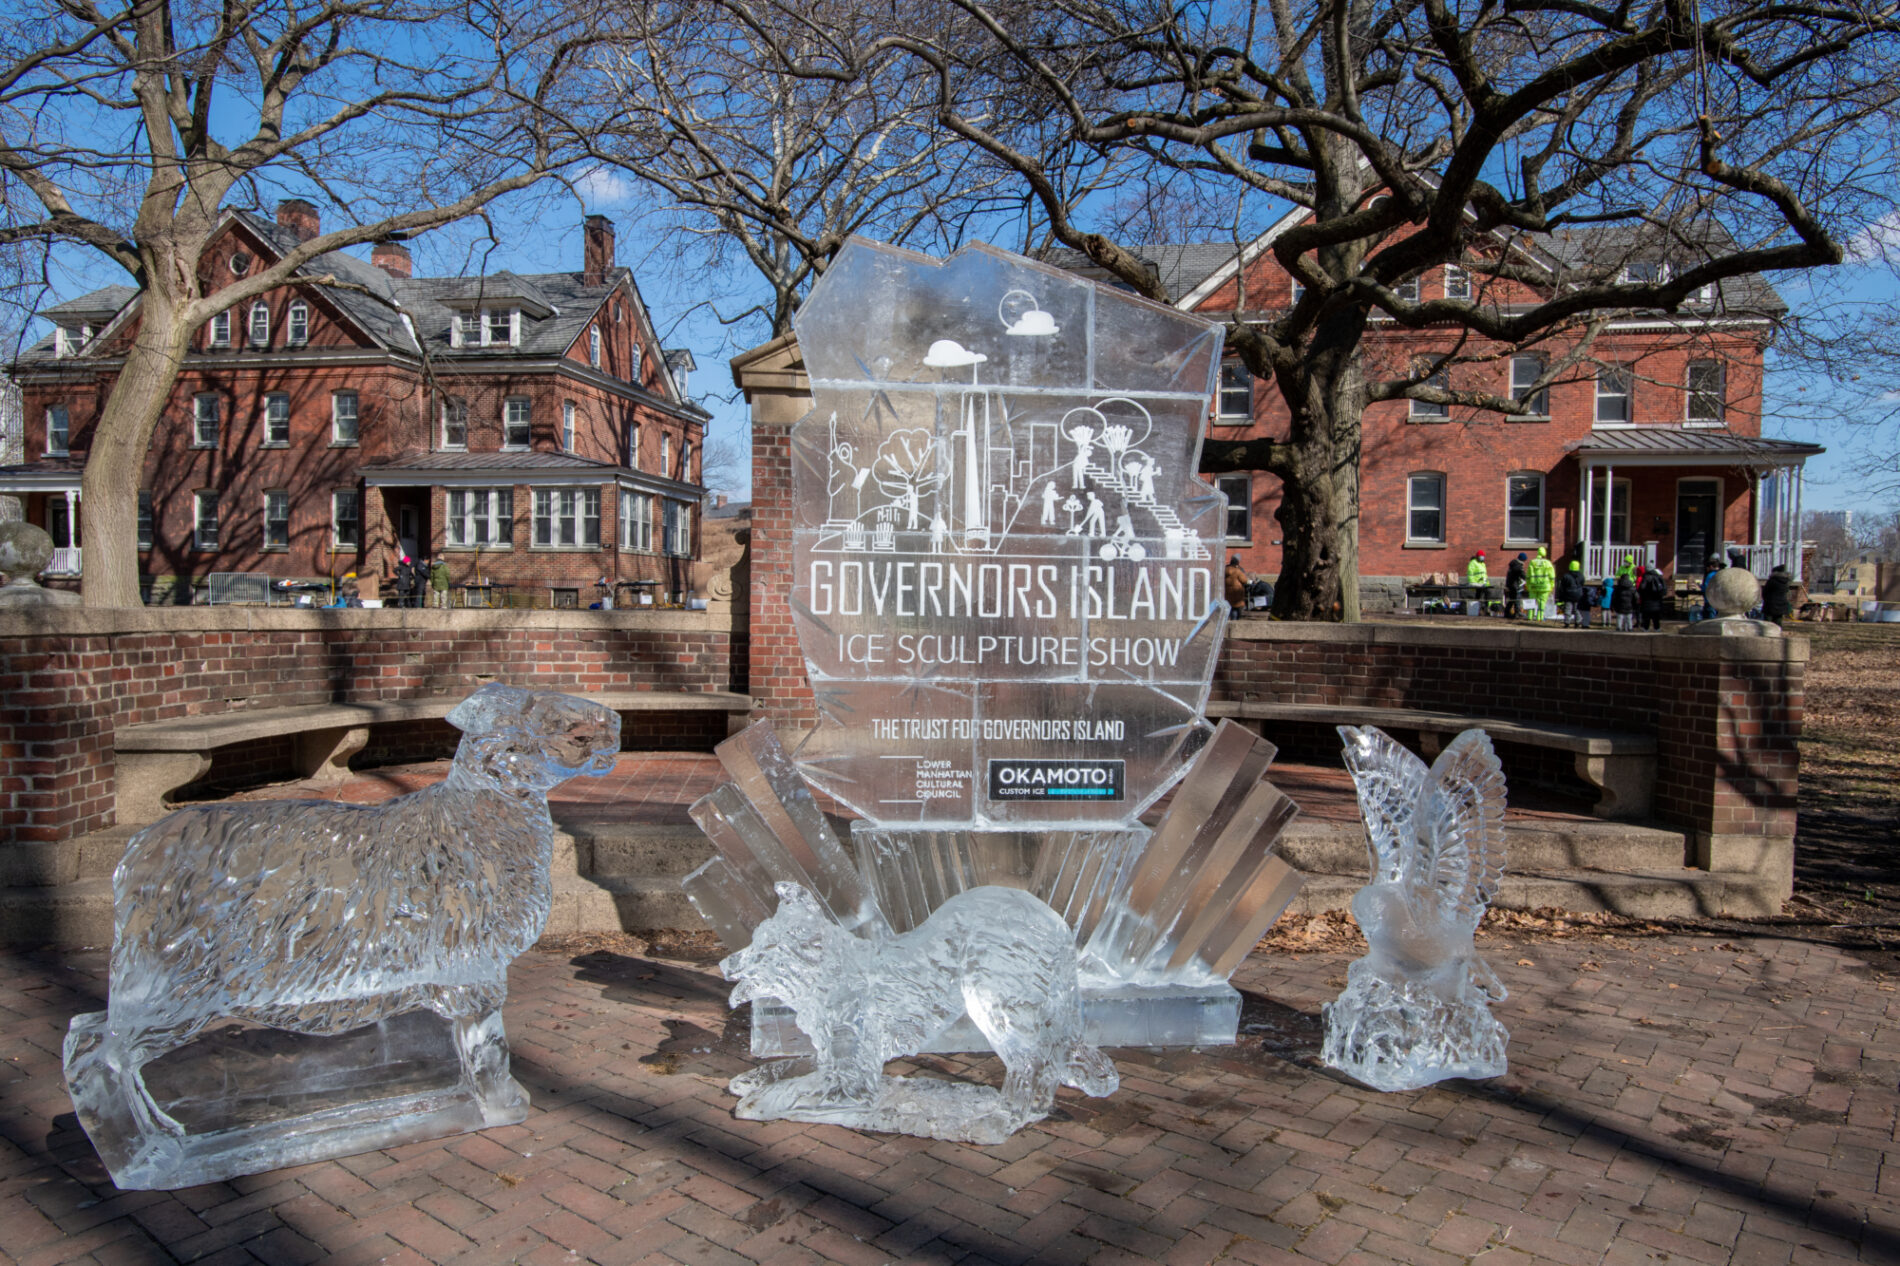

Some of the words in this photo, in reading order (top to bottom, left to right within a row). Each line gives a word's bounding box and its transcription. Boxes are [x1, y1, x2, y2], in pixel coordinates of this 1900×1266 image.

[810, 560, 1058, 618] GOVERNORS
[1070, 565, 1212, 621] ISLAND
[839, 633, 885, 663] ICE
[898, 634, 1078, 665] SCULPTURE
[1089, 637, 1181, 666] SHOW
[872, 718, 900, 740] THE
[901, 718, 950, 740] TRUST
[952, 719, 980, 740] FOR
[983, 719, 1071, 741] GOVERNORS
[1073, 720, 1125, 741] ISLAND
[916, 760, 952, 769] LOWER
[916, 770, 973, 779] MANHATTAN
[999, 768, 1107, 784] OKAMOTO
[916, 780, 964, 789] CULTURAL
[915, 790, 962, 799] COUNCIL
